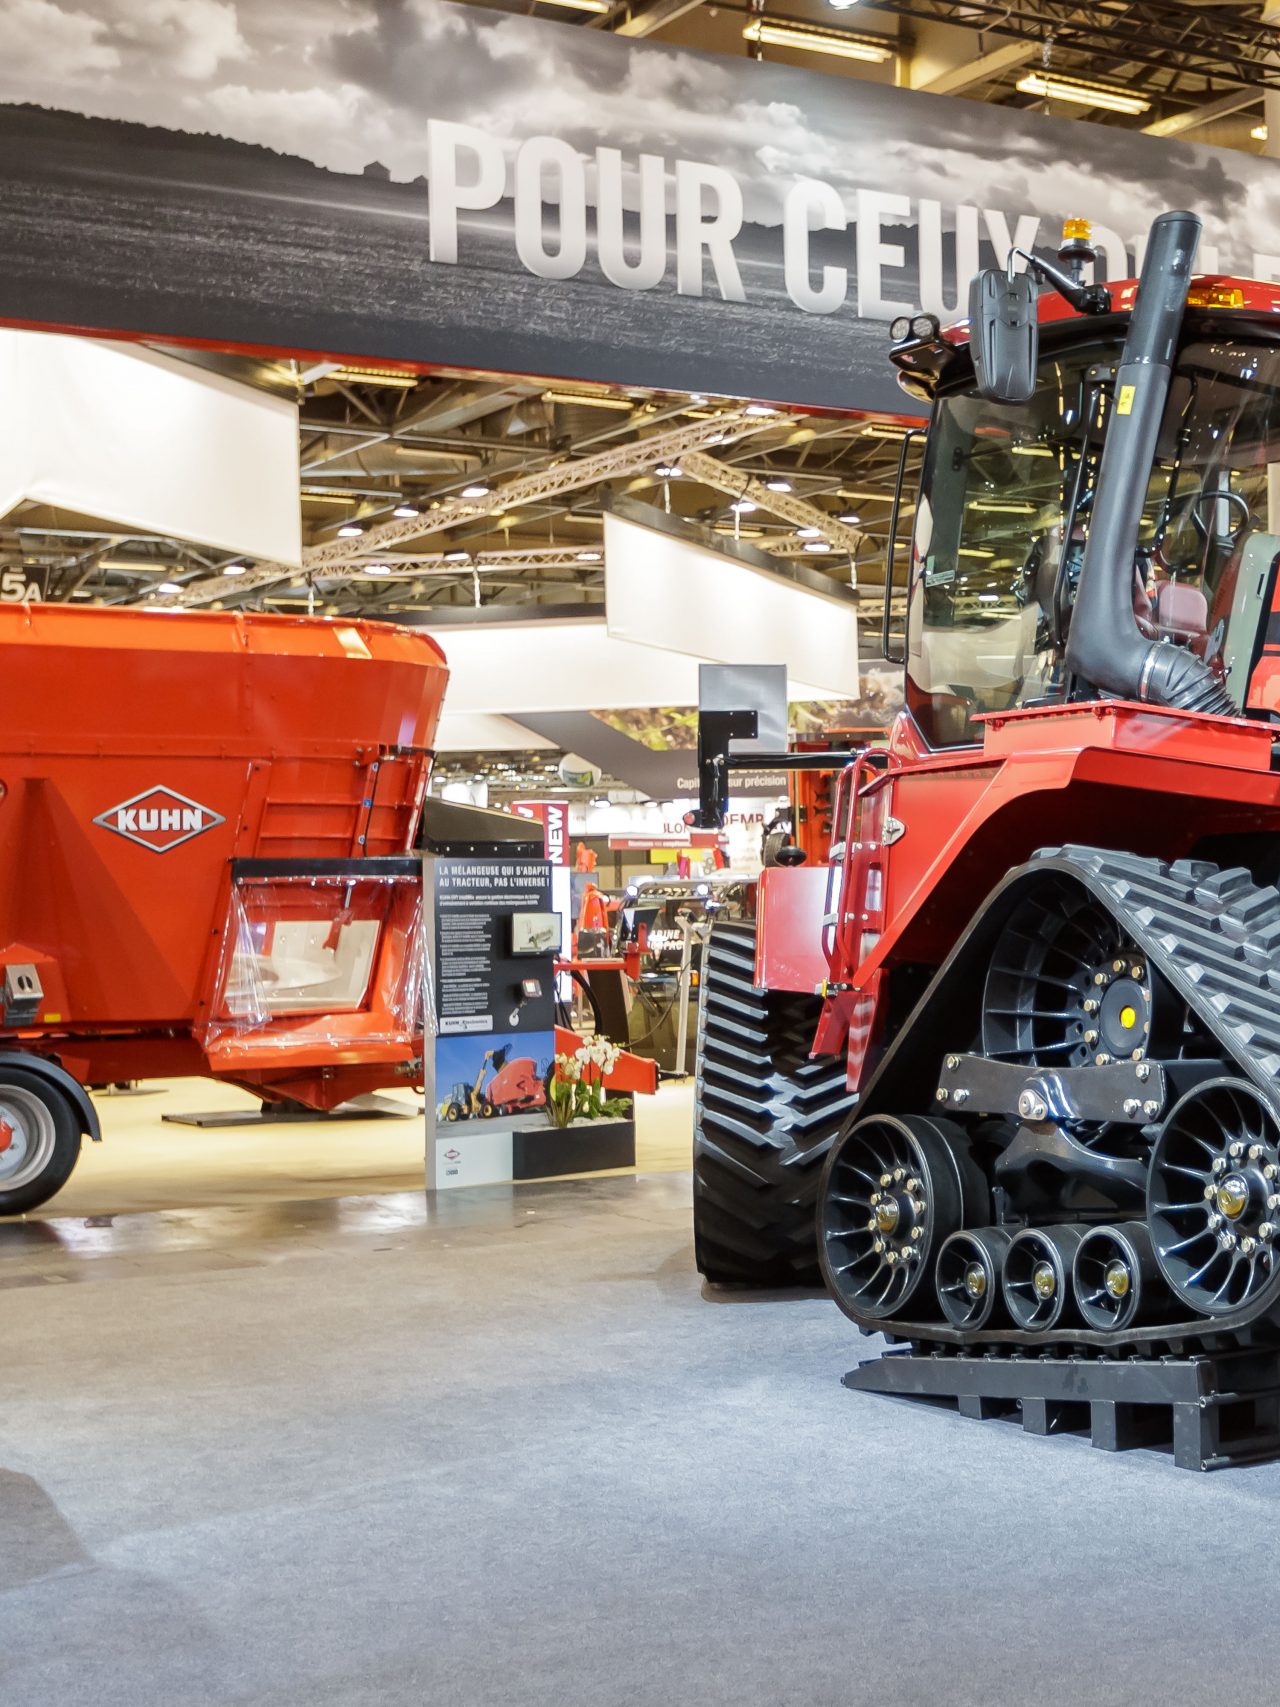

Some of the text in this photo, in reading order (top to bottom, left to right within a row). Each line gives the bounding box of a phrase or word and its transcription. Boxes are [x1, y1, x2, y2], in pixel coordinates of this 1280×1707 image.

[427, 118, 748, 302] POUR
[744, 775, 787, 789] précision
[117, 808, 203, 831] KUHN
[548, 805, 563, 864] NEW
[439, 864, 549, 876] LA MÉLANGEUSE QUI S'ADAPTE
[439, 878, 449, 887] AU
[452, 877, 492, 888] TRACTEUR,
[494, 877, 508, 887] PAS
[510, 877, 545, 887] L'INVERSE
